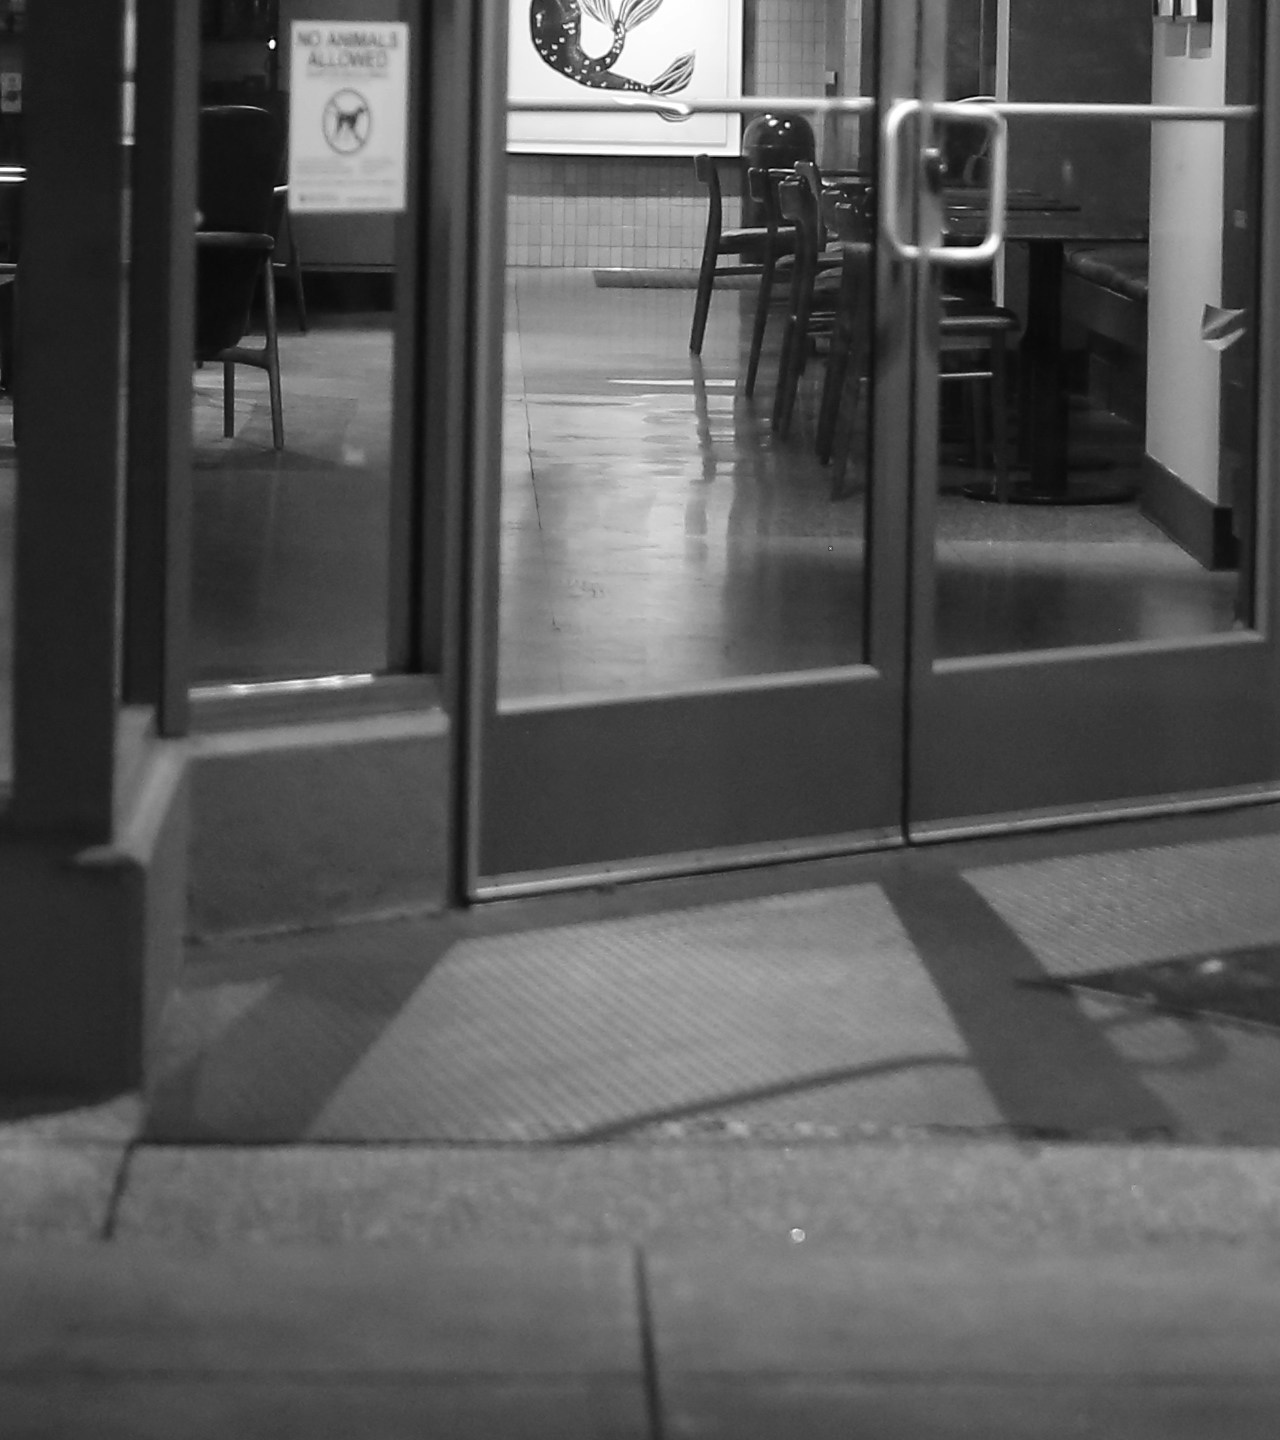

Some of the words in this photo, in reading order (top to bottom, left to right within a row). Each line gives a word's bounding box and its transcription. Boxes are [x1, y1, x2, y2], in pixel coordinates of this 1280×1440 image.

[297, 29, 321, 47] NO
[327, 29, 399, 48] ANIMALS
[308, 49, 388, 68] ALLOWED
